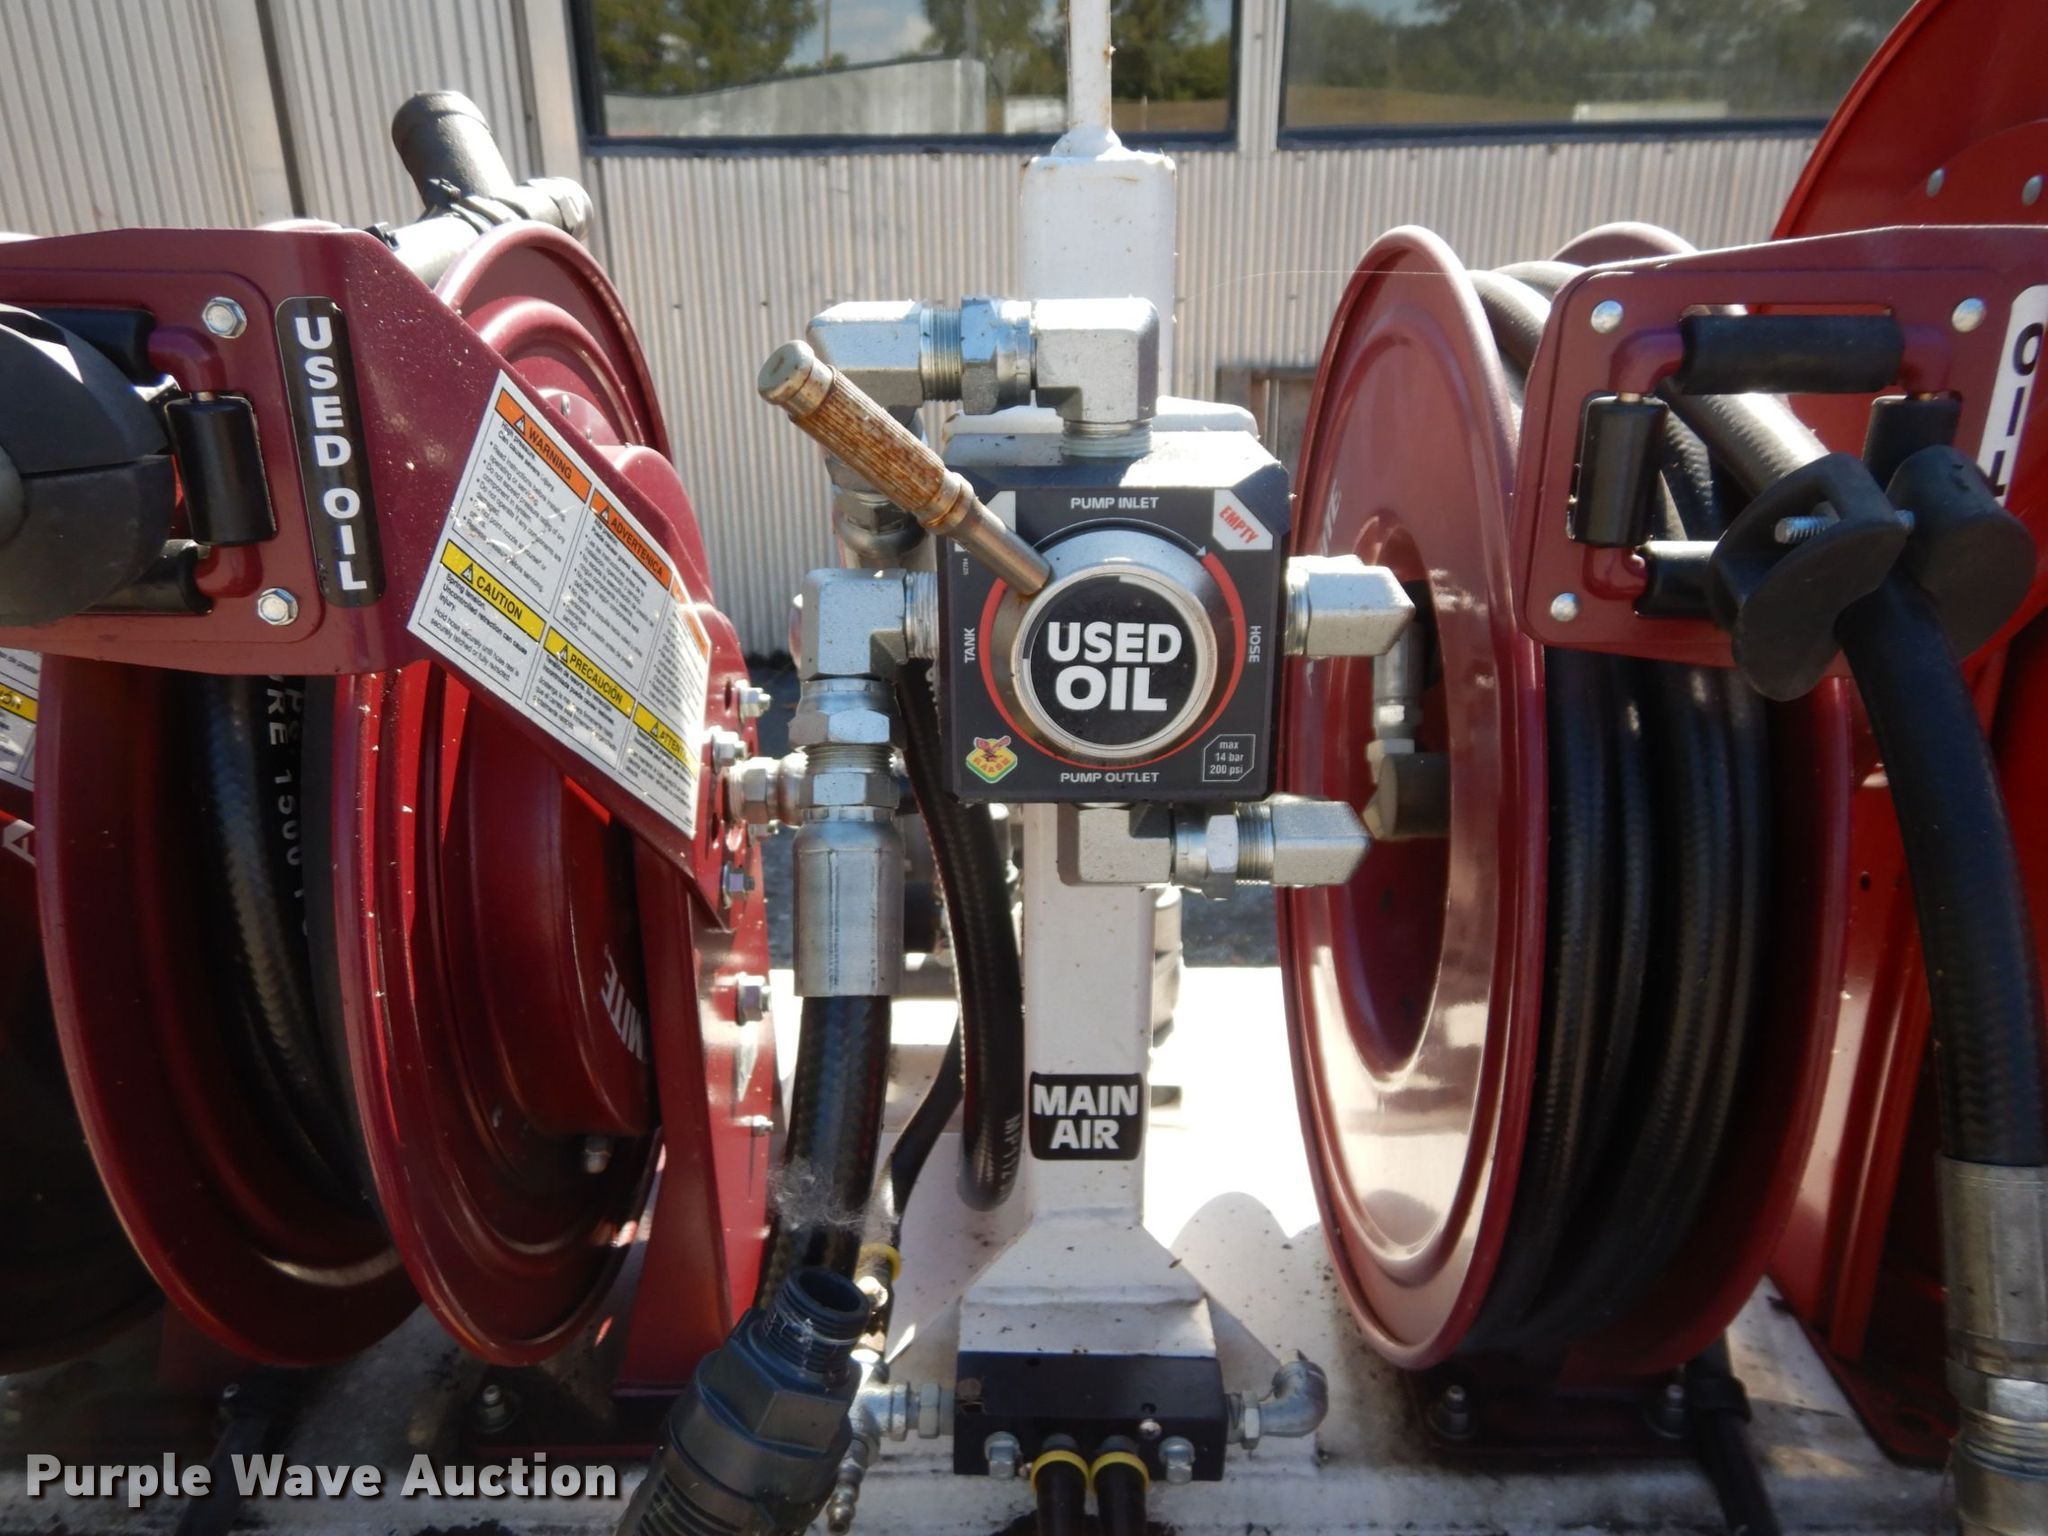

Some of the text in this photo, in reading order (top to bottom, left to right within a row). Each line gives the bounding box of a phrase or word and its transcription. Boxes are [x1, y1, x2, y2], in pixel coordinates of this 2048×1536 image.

[295, 316, 367, 591] USED OIL
[508, 442, 524, 461] cause
[527, 427, 572, 480] WARNING
[1070, 497, 1160, 509] PUMP INLET
[1218, 505, 1259, 545] EMPTY
[445, 572, 465, 594] Spring
[475, 573, 522, 621] CAUTION
[964, 627, 976, 664] TANK
[1047, 621, 1183, 664] USED
[1249, 625, 1262, 664] HOSE
[569, 649, 623, 705] PRECAUCIÓN
[1056, 665, 1168, 712] OIL
[266, 675, 289, 746] RE
[1215, 752, 1245, 762] 14 bar
[1219, 742, 1240, 750] max
[1060, 771, 1160, 784] PUMP OUTLET
[1210, 764, 1244, 777] 200 psi
[1032, 1084, 1139, 1116] MAIN
[1050, 1119, 1120, 1150] AIR
